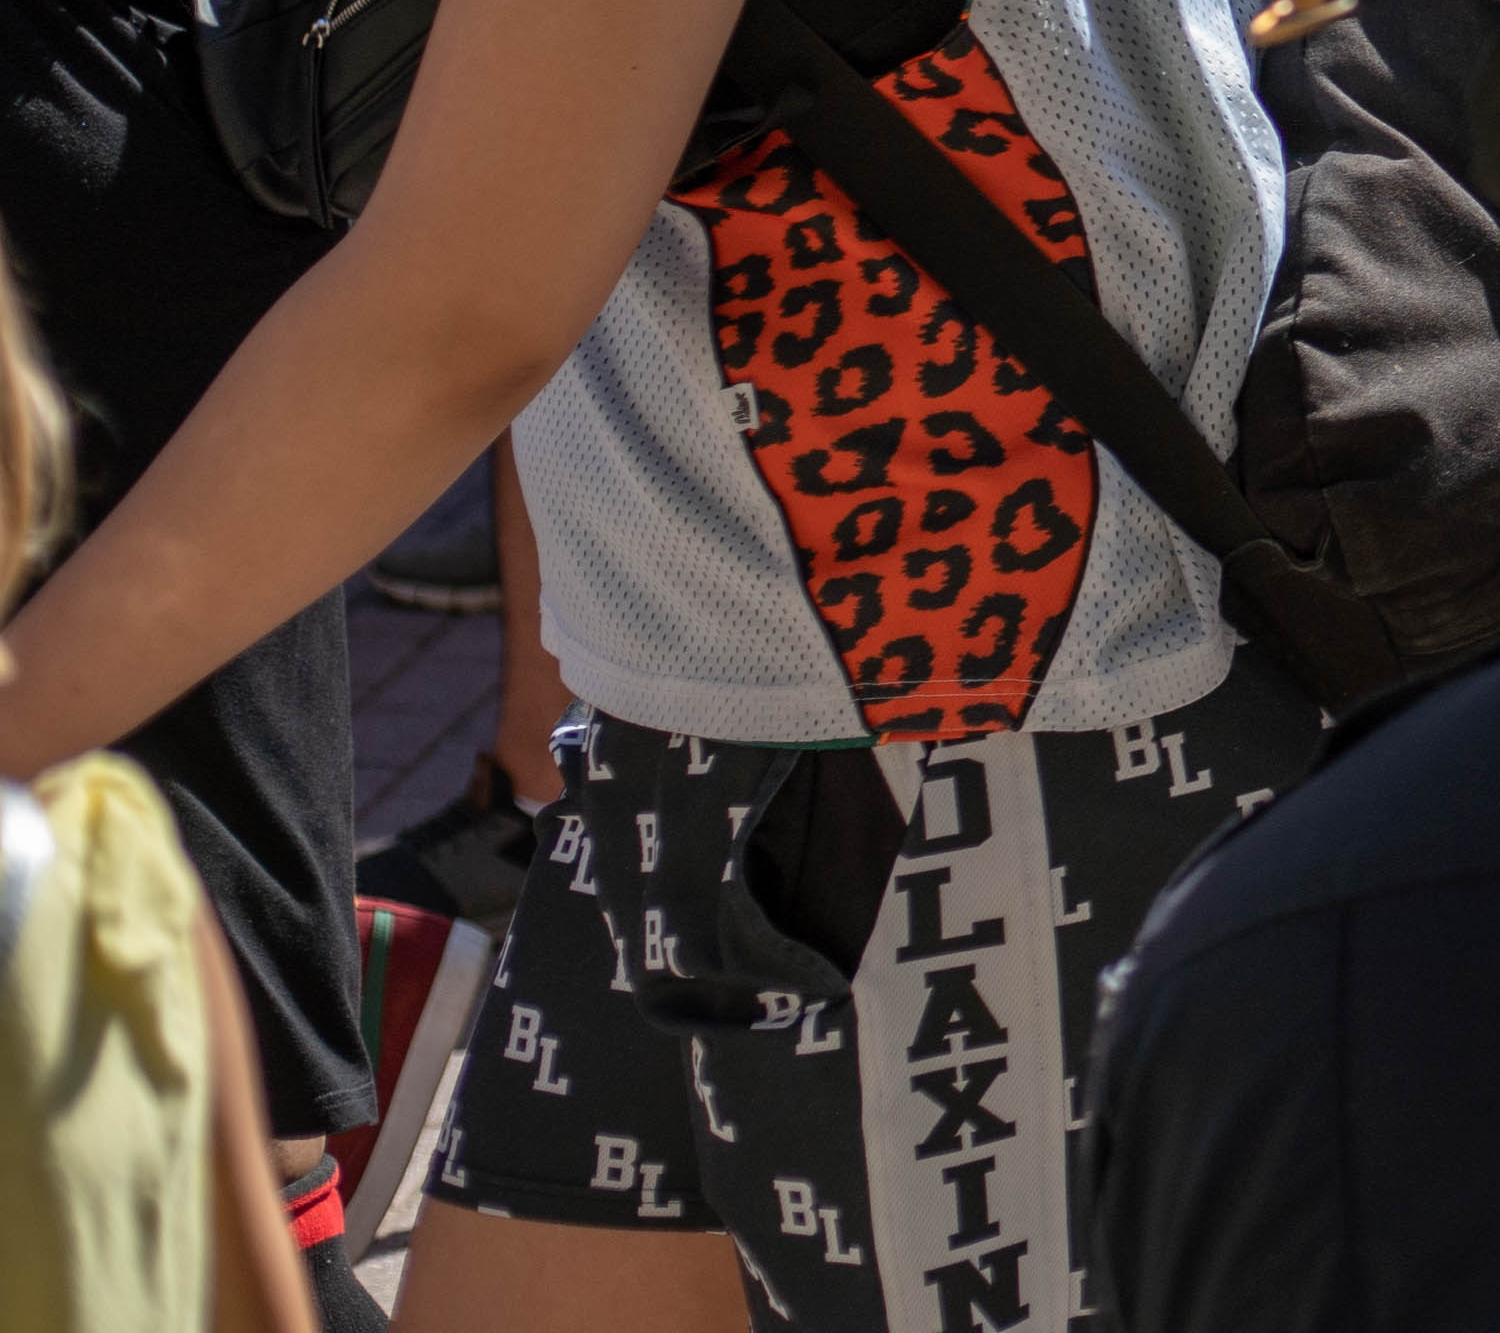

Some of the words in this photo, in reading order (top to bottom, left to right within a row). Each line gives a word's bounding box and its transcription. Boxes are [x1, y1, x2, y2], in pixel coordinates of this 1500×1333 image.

[1112, 717, 1213, 799] BL
[550, 815, 599, 896] BL
[503, 1004, 570, 1096] BL
[750, 990, 842, 1056] BL
[590, 1134, 683, 1218] BL
[772, 1179, 863, 1266] BL
